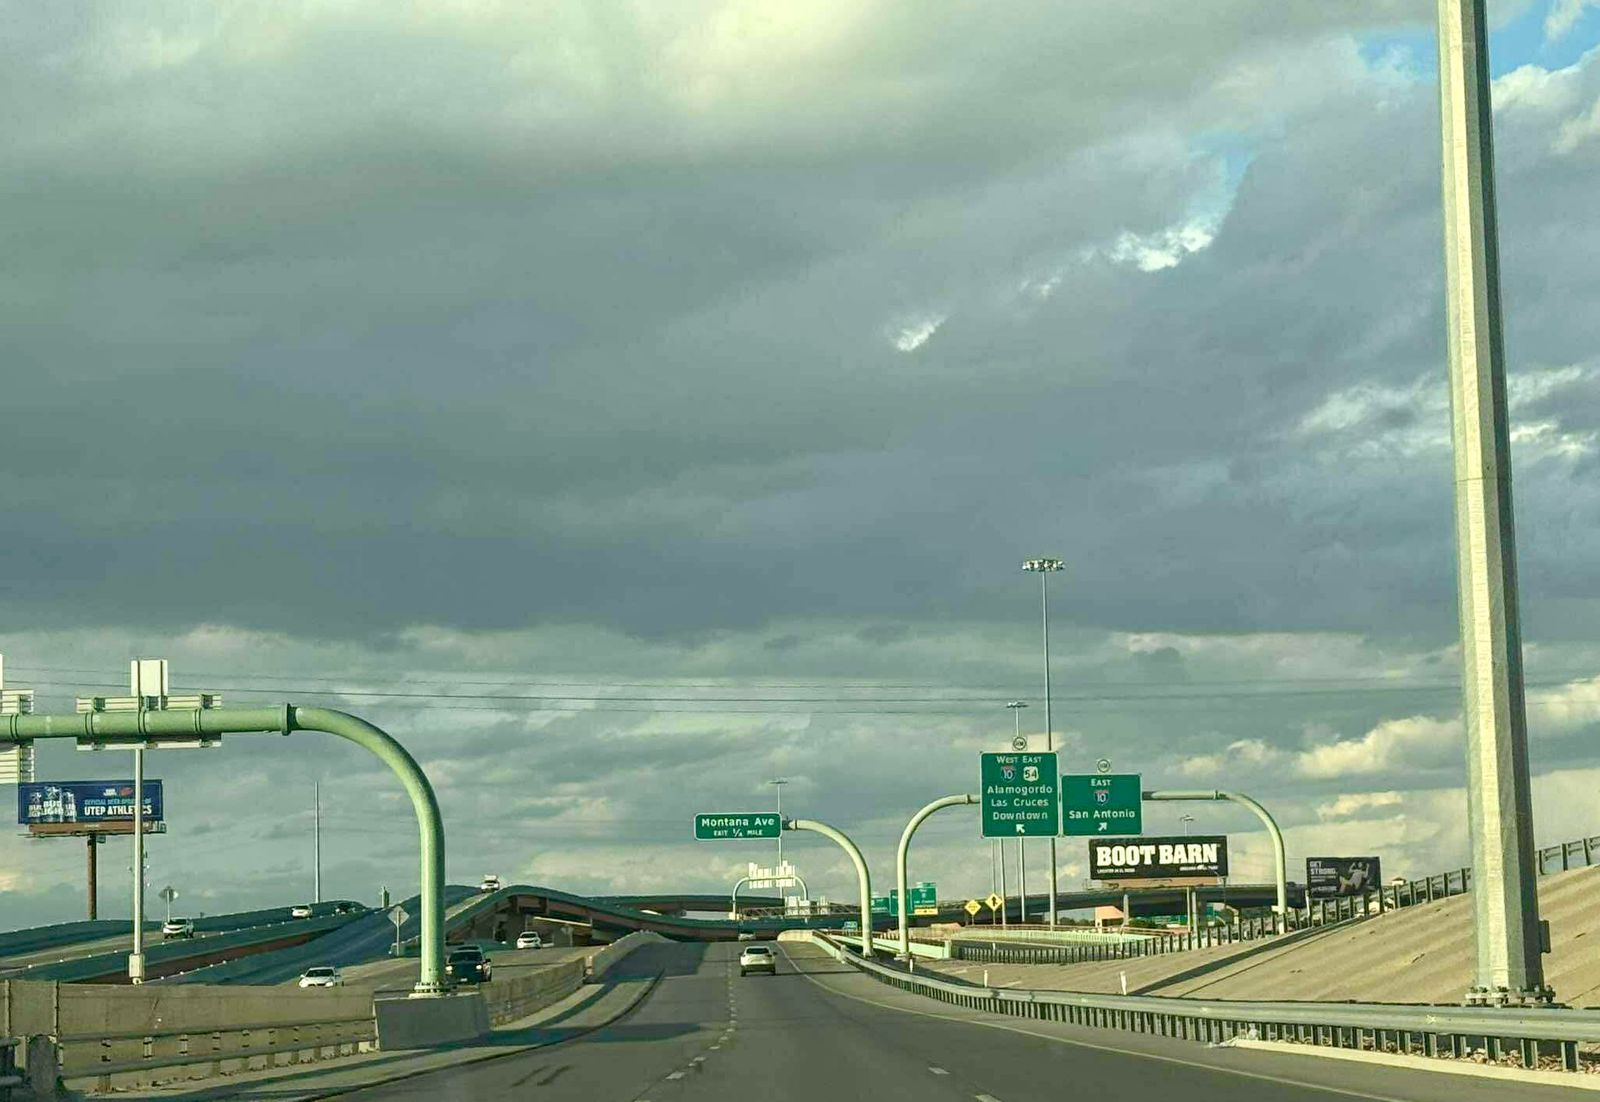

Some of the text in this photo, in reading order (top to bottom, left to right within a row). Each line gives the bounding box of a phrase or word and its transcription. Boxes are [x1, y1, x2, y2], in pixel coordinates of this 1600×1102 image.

[1022, 756, 1042, 764] EAST
[1003, 770, 1013, 779] 10
[1024, 769, 1037, 779] 54
[1091, 778, 1111, 787] EAST
[987, 784, 1053, 796] Alamogordo
[1097, 793, 1106, 802] 10
[991, 798, 1049, 807] Las Cruces
[84, 806, 106, 816] UTEP
[107, 805, 152, 815] ATHLECS
[1069, 808, 1136, 819] San Antonio
[993, 811, 1048, 820] Downtown
[701, 816, 775, 827] Montana Ave
[713, 829, 728, 837] EXIT
[1096, 843, 1218, 866] BOOT BARN
